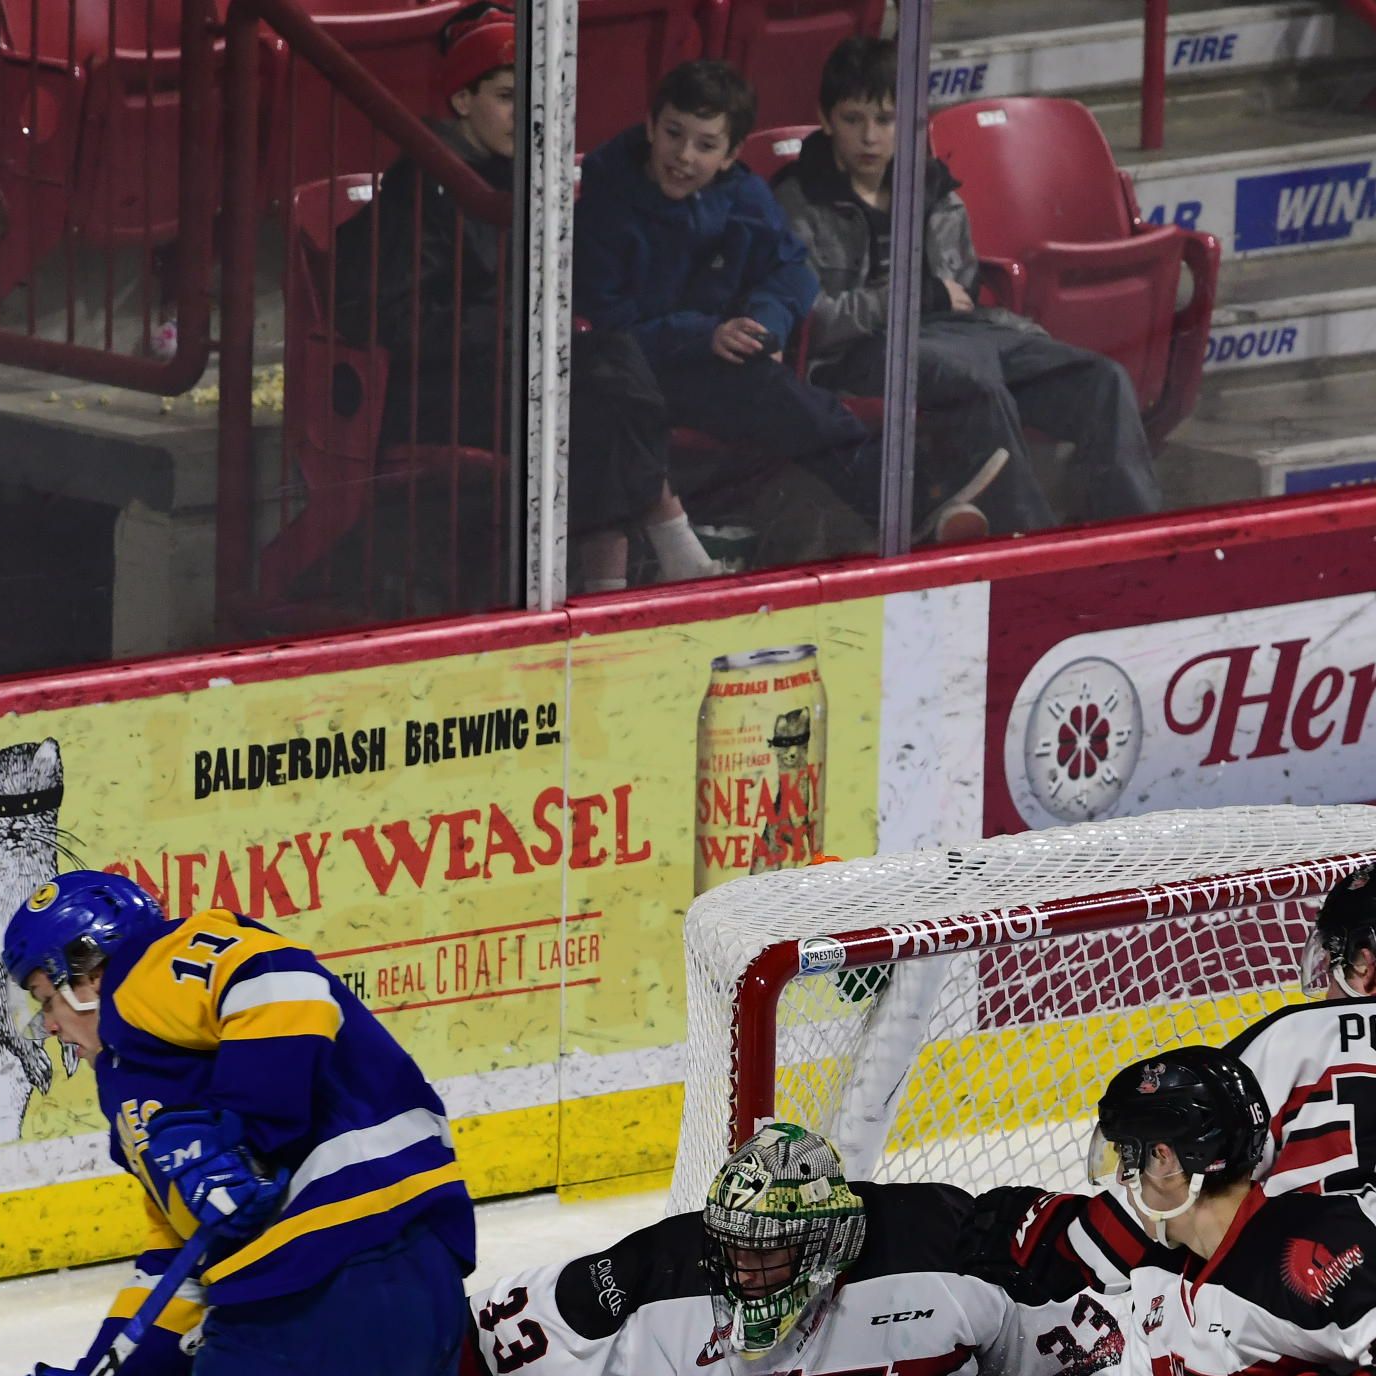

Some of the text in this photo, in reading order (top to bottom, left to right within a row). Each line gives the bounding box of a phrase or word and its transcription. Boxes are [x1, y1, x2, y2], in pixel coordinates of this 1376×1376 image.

[1173, 34, 1239, 66] FIRE
[928, 64, 988, 95] FIRE
[194, 727, 387, 800] BALDERDASH
[405, 707, 529, 768] BREWING
[697, 762, 823, 828] SNEAKY
[343, 785, 651, 896] WEASEL
[697, 820, 824, 870] WEASEL
[809, 949, 844, 962] PRESTIGE
[883, 904, 1054, 959] PRESTIGE
[168, 931, 241, 992] 11
[377, 961, 426, 998] REAL
[436, 934, 527, 995] CRAFT
[538, 934, 601, 971] LAGER
[1249, 1102, 1264, 1125] 16
[478, 1286, 549, 1374] 33
[870, 1308, 935, 1326] CCM
